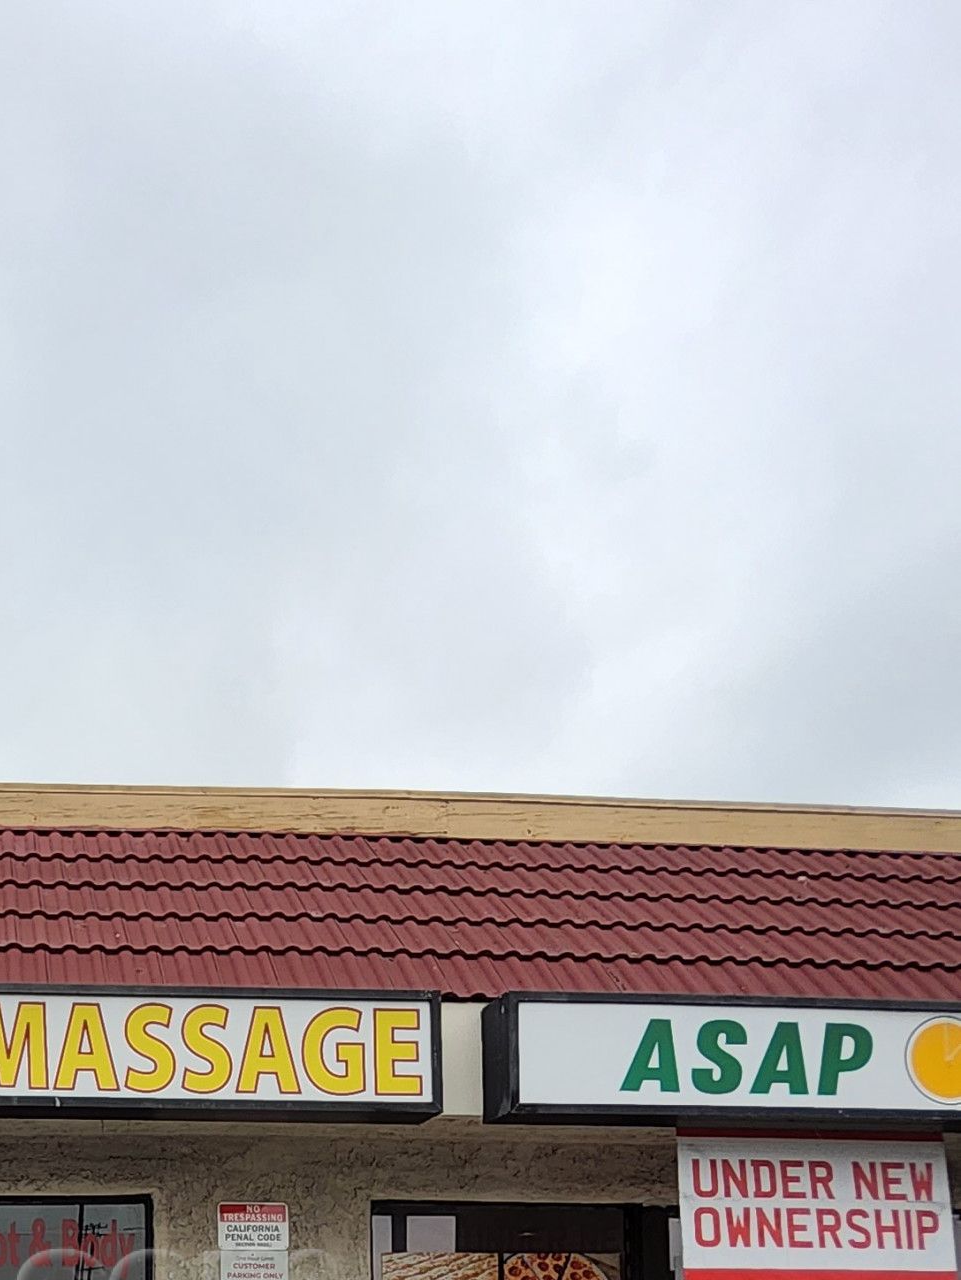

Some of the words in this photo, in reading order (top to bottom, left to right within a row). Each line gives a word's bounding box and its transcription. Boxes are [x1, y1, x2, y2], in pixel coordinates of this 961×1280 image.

[619, 1018, 874, 1097] ASAP
[691, 1158, 834, 1200] UNDER
[852, 1160, 933, 1202] NEW
[246, 1205, 261, 1213] NO
[223, 1213, 283, 1222] TRESPASSING
[226, 1224, 280, 1232] CALIFORNIA
[693, 1206, 941, 1251] OWNERSHIP
[225, 1233, 254, 1241] PENAL
[257, 1233, 282, 1241] CODE
[61, 1217, 135, 1280] Body
[232, 1262, 276, 1270] CUSTOMER
[262, 1272, 284, 1280] ONLY
